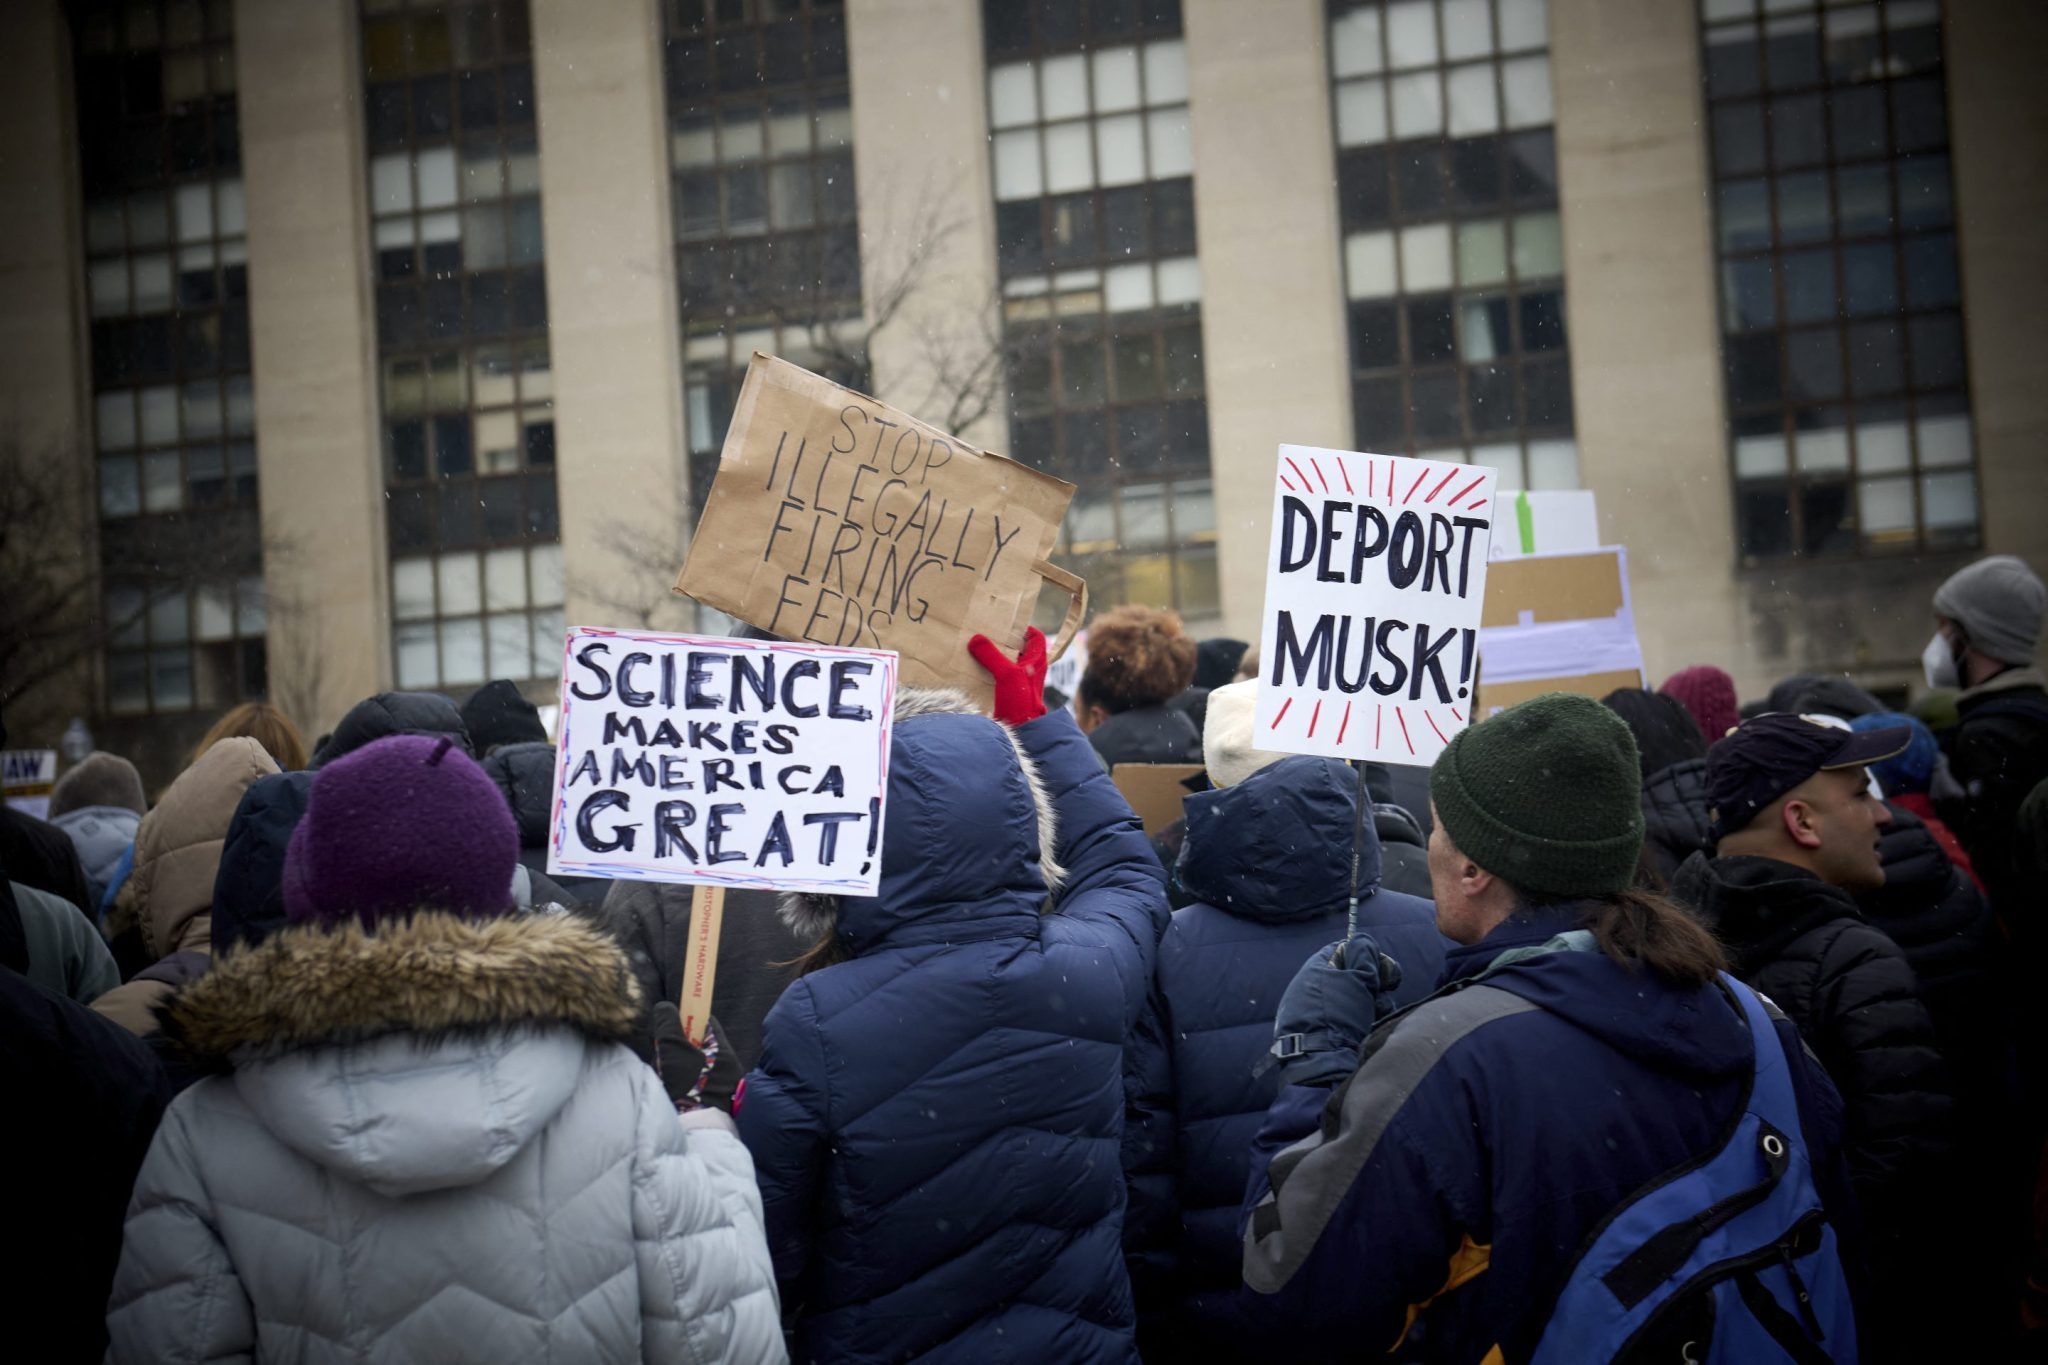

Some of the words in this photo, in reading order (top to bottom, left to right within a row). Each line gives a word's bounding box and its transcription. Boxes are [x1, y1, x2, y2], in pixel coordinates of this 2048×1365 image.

[832, 405, 953, 485] STOP
[766, 430, 1020, 581] ILLEGALLY
[763, 501, 944, 624] FIRING
[1278, 495, 1490, 599] DEPORT
[769, 574, 895, 649] FEDS
[570, 642, 873, 722] SCIENCE
[1271, 609, 1476, 704] MUSK!
[0, 757, 43, 779] AW
[568, 748, 845, 798] AMERICA
[602, 711, 800, 755] MAKES
[575, 789, 881, 876] GREAT!
[693, 944, 707, 998] HARDWARE
